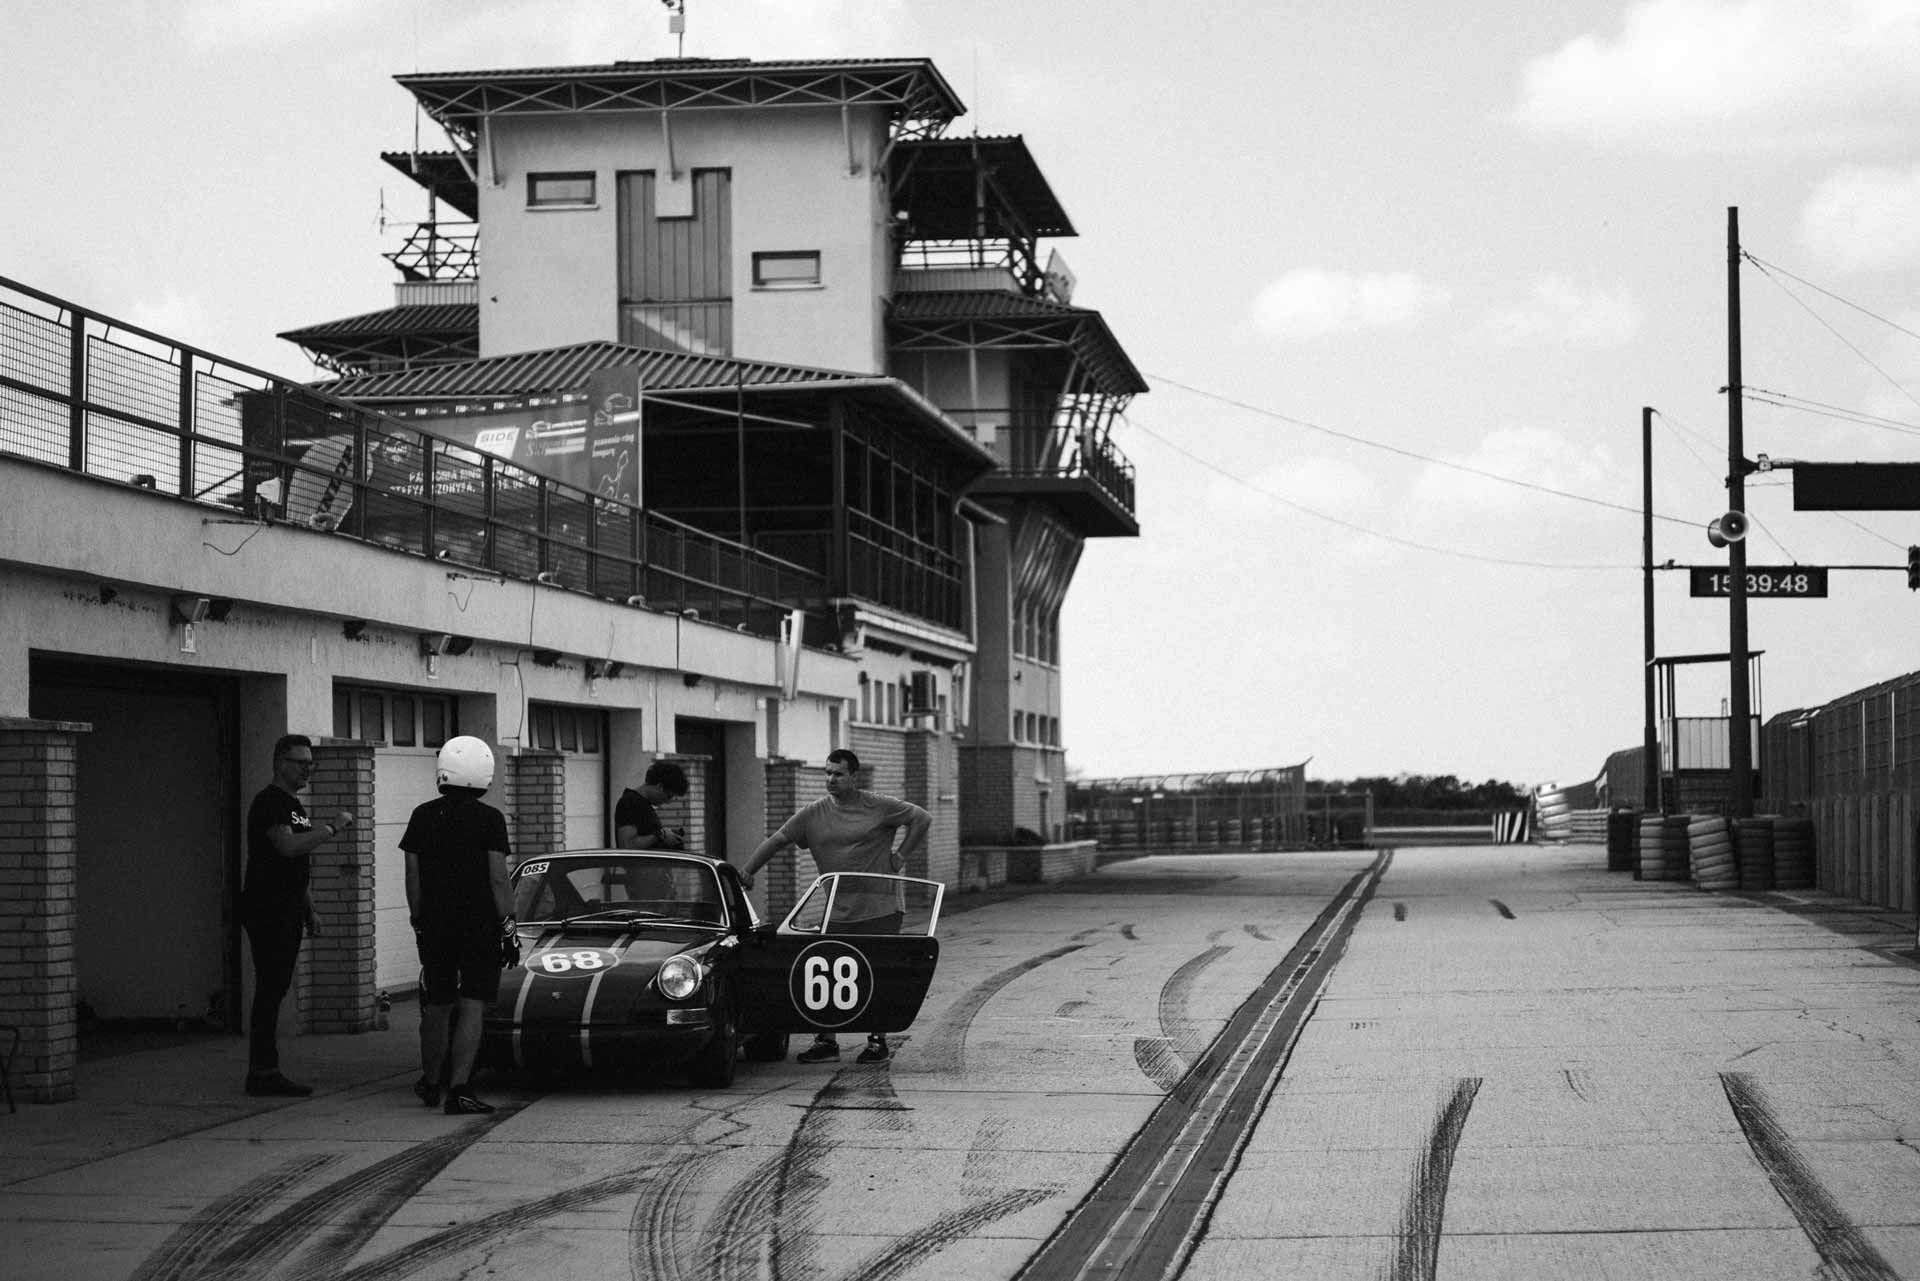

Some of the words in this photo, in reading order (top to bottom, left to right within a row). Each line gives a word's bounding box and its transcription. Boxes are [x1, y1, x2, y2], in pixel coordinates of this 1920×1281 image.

[1709, 573, 1809, 593] 1539:48
[523, 863, 548, 875] 085
[541, 951, 604, 974] 68
[804, 955, 859, 1011] 68
